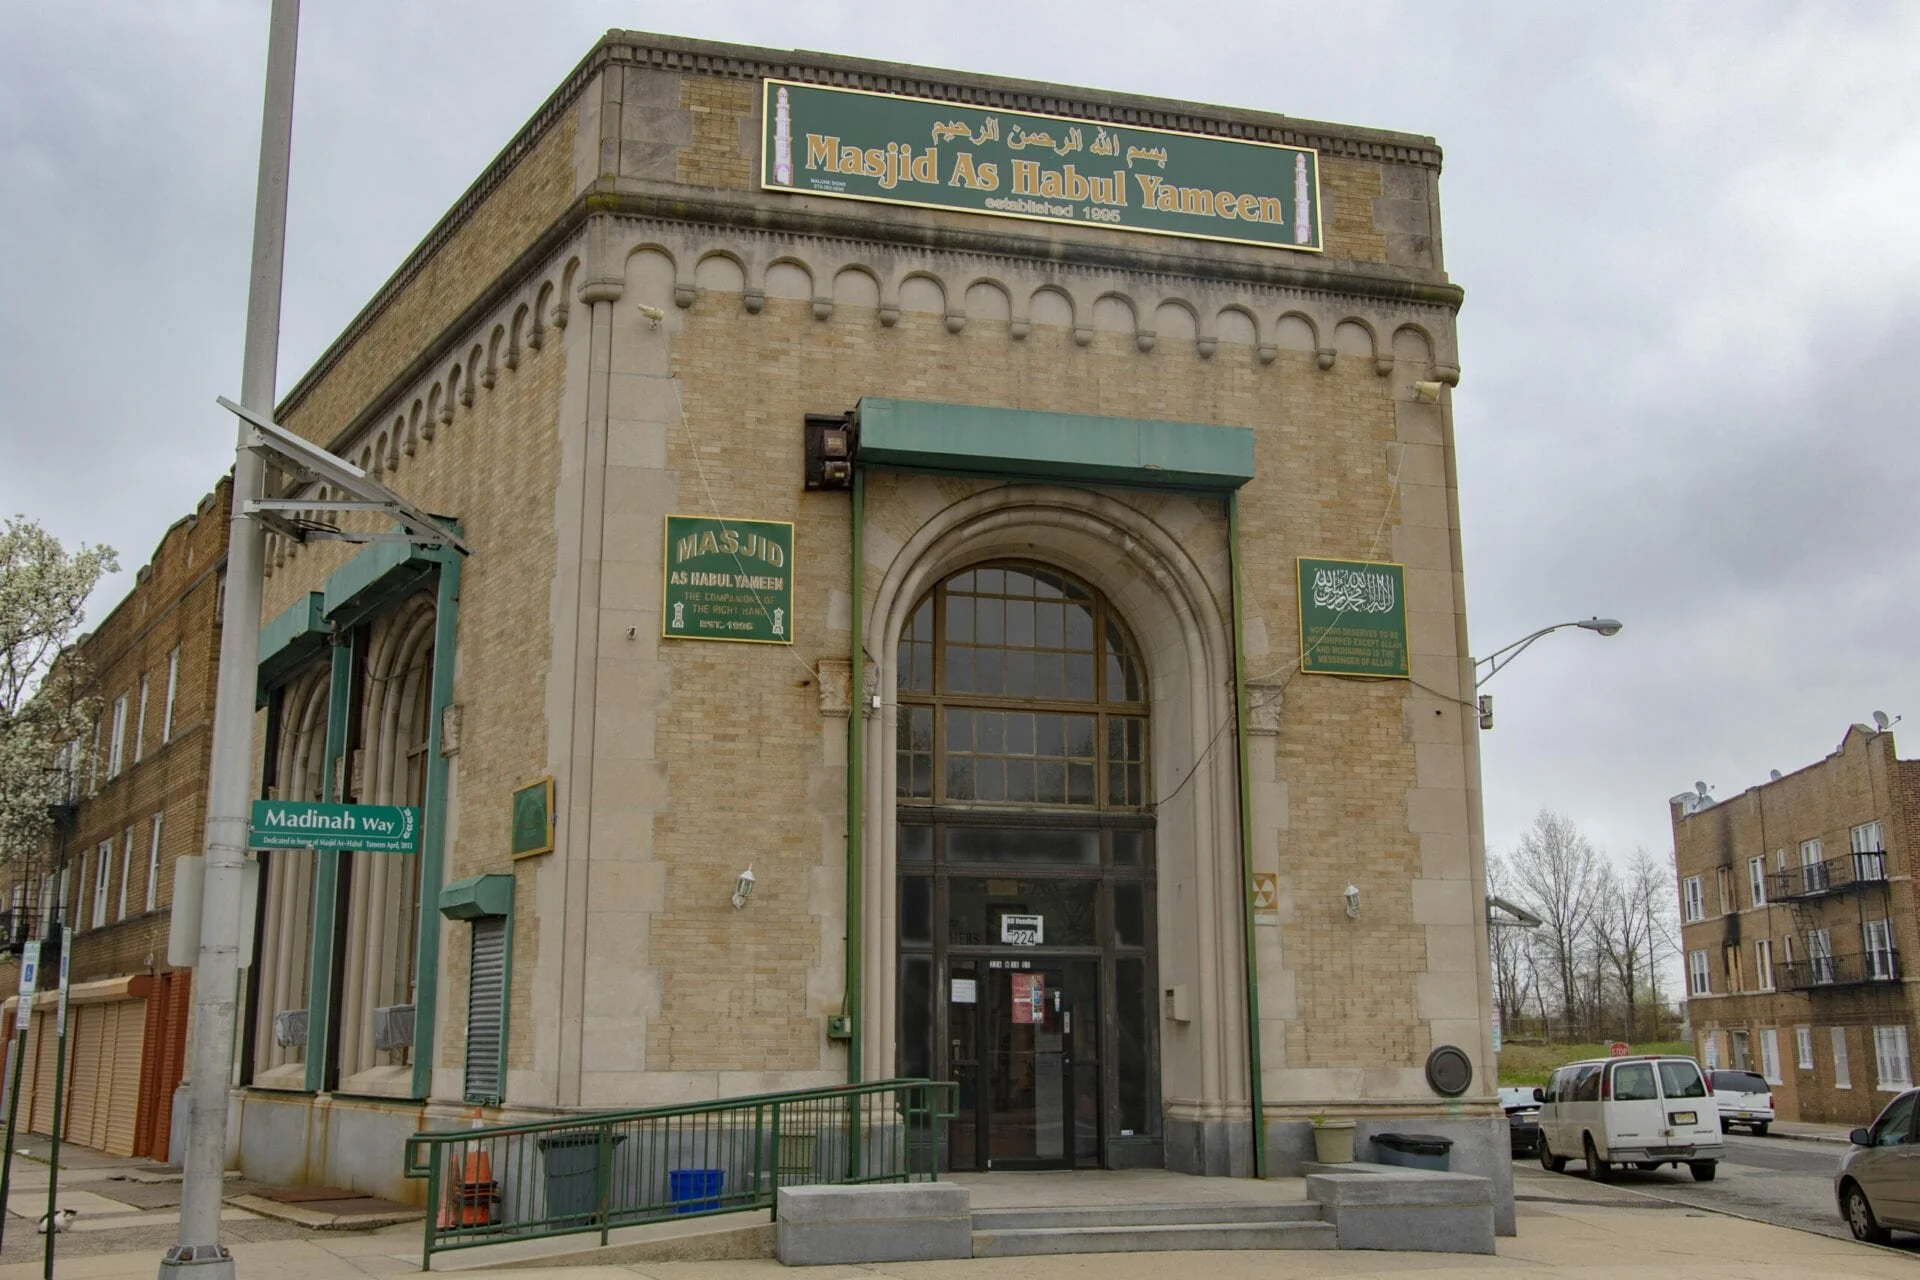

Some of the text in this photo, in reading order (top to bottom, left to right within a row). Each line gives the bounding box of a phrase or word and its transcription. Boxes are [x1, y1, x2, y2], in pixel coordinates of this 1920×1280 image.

[931, 116, 1168, 169] بسم الله الرحمن الرحيم
[805, 133, 1285, 225] Masjid As Habul Yameen
[984, 197, 1074, 217] established
[676, 529, 784, 568] MASJID
[670, 571, 784, 591] AS HABUL YAMEEN
[684, 591, 701, 601] THE
[692, 603, 768, 616] THE RIGHT HAND
[265, 808, 355, 830] Madinah
[362, 817, 395, 834] Way
[263, 836, 290, 845] Dedicated
[1013, 931, 1035, 945] 224
[1611, 1047, 1629, 1057] STOP
